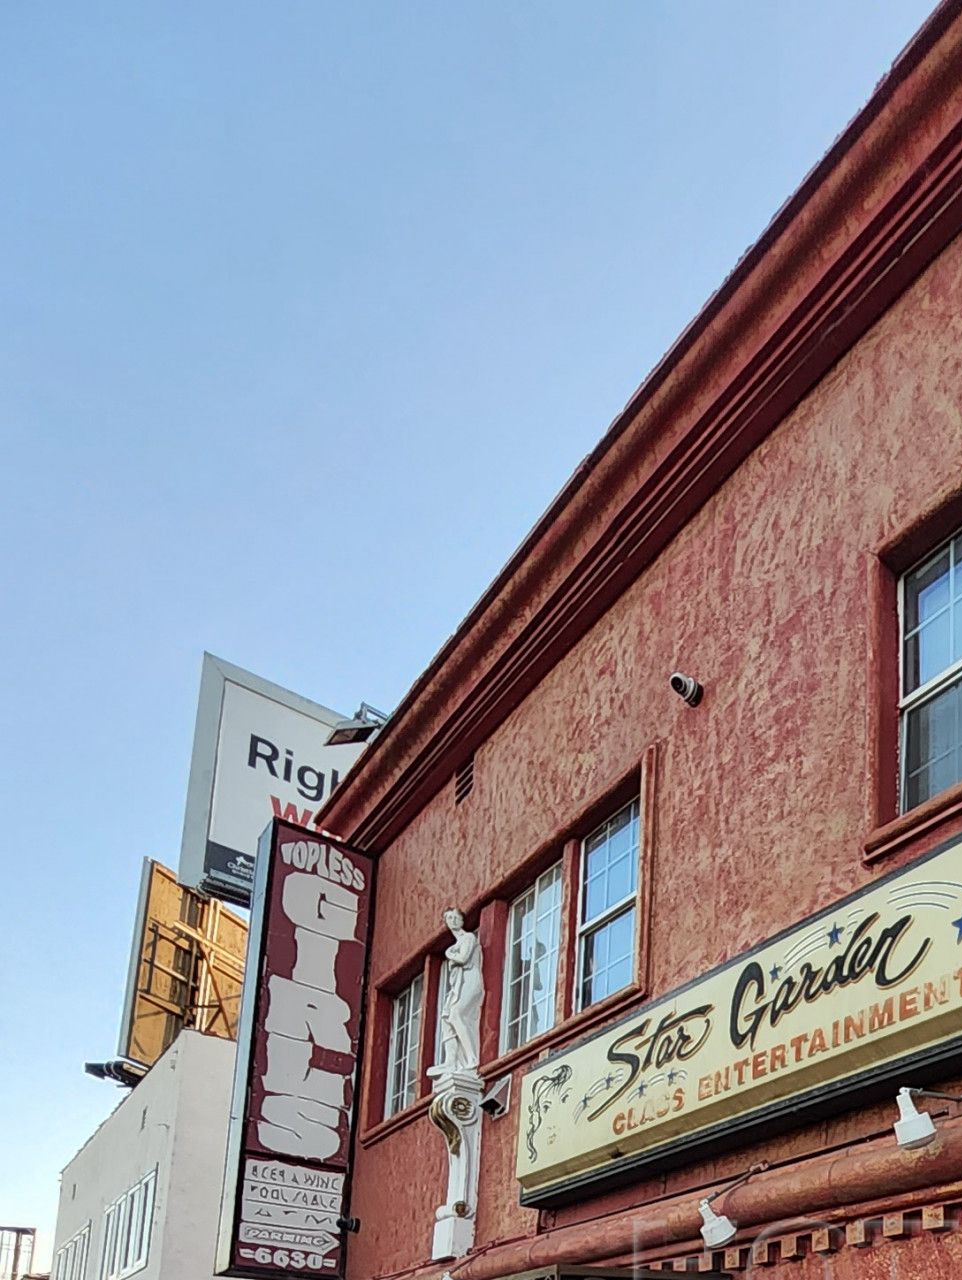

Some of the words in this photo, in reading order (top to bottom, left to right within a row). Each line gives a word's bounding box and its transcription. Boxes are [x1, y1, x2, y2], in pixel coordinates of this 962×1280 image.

[280, 840, 365, 891] TOPLESS
[256, 871, 360, 1160] GIRLS
[587, 1003, 714, 1122] Star
[728, 912, 933, 1052] Garden
